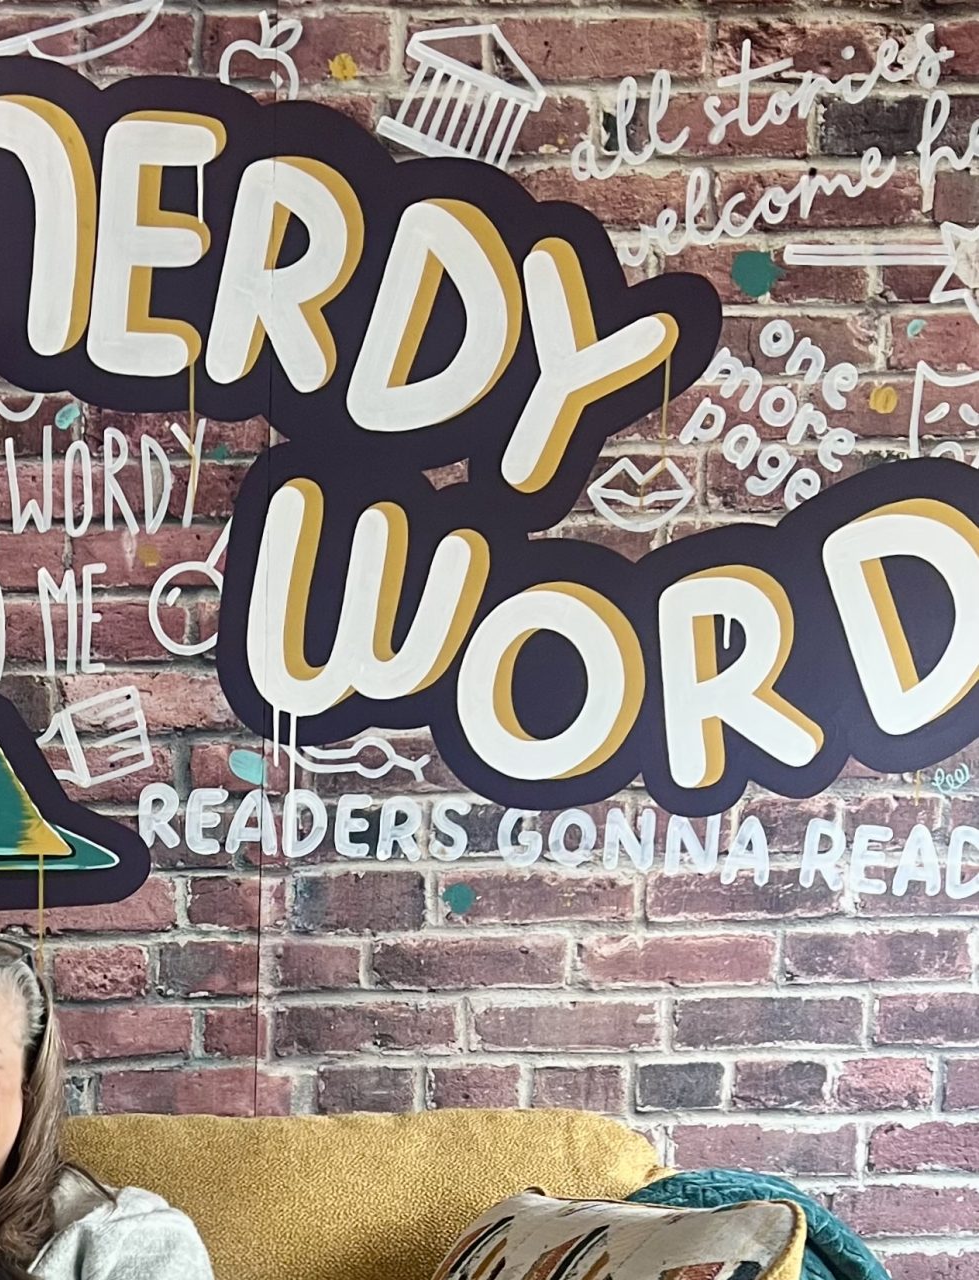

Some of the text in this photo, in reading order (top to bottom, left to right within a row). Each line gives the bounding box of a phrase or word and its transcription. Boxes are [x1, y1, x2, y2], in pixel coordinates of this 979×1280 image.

[571, 23, 956, 182] all stories
[704, 347, 857, 473] more
[759, 319, 858, 411] one
[4, 418, 207, 538] WORDY
[679, 397, 821, 511] page
[38, 562, 107, 674] ME
[246, 476, 979, 789] WORD
[138, 782, 979, 900] READERS GONNA READ
